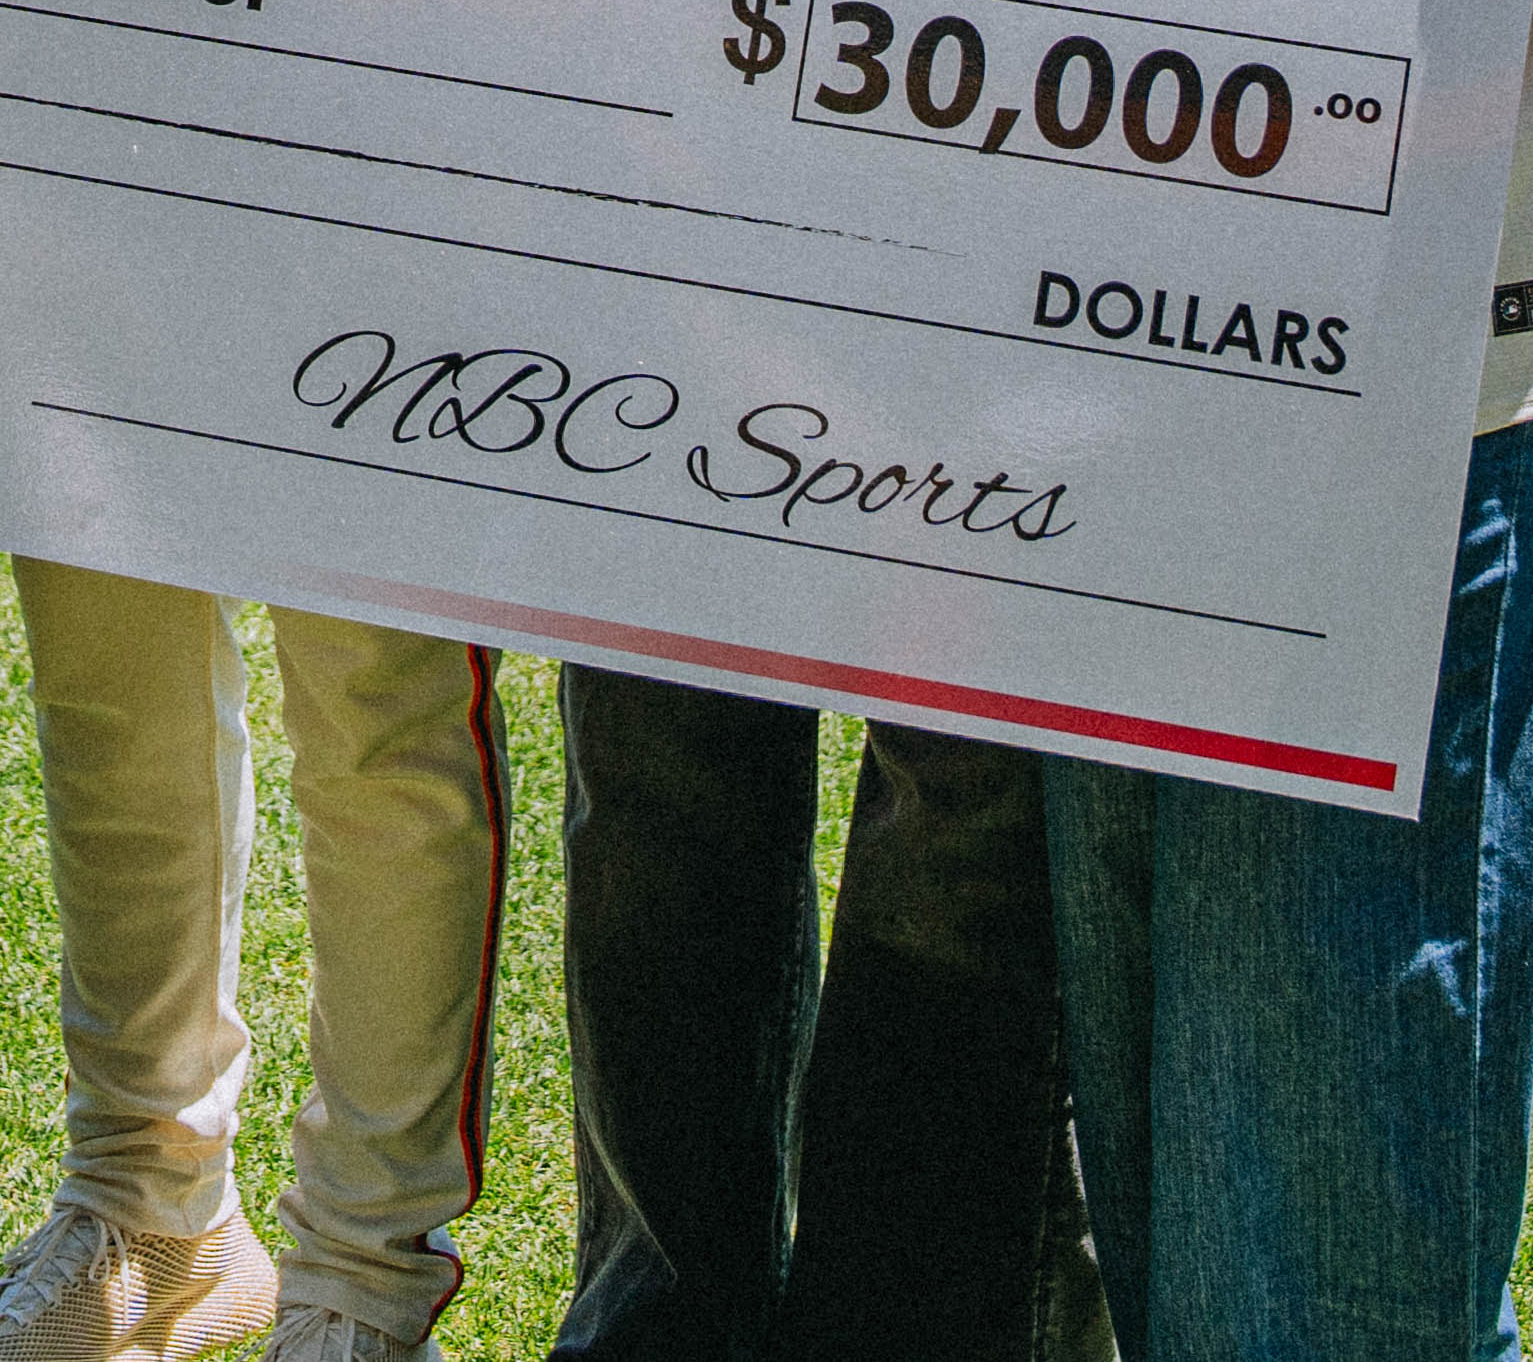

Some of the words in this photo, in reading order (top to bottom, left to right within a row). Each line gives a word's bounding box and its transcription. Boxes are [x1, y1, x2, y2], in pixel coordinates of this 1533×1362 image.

[1033, 269, 1352, 376] DOLLARS
[292, 329, 680, 474] NBC
[686, 401, 1078, 543] Sports
